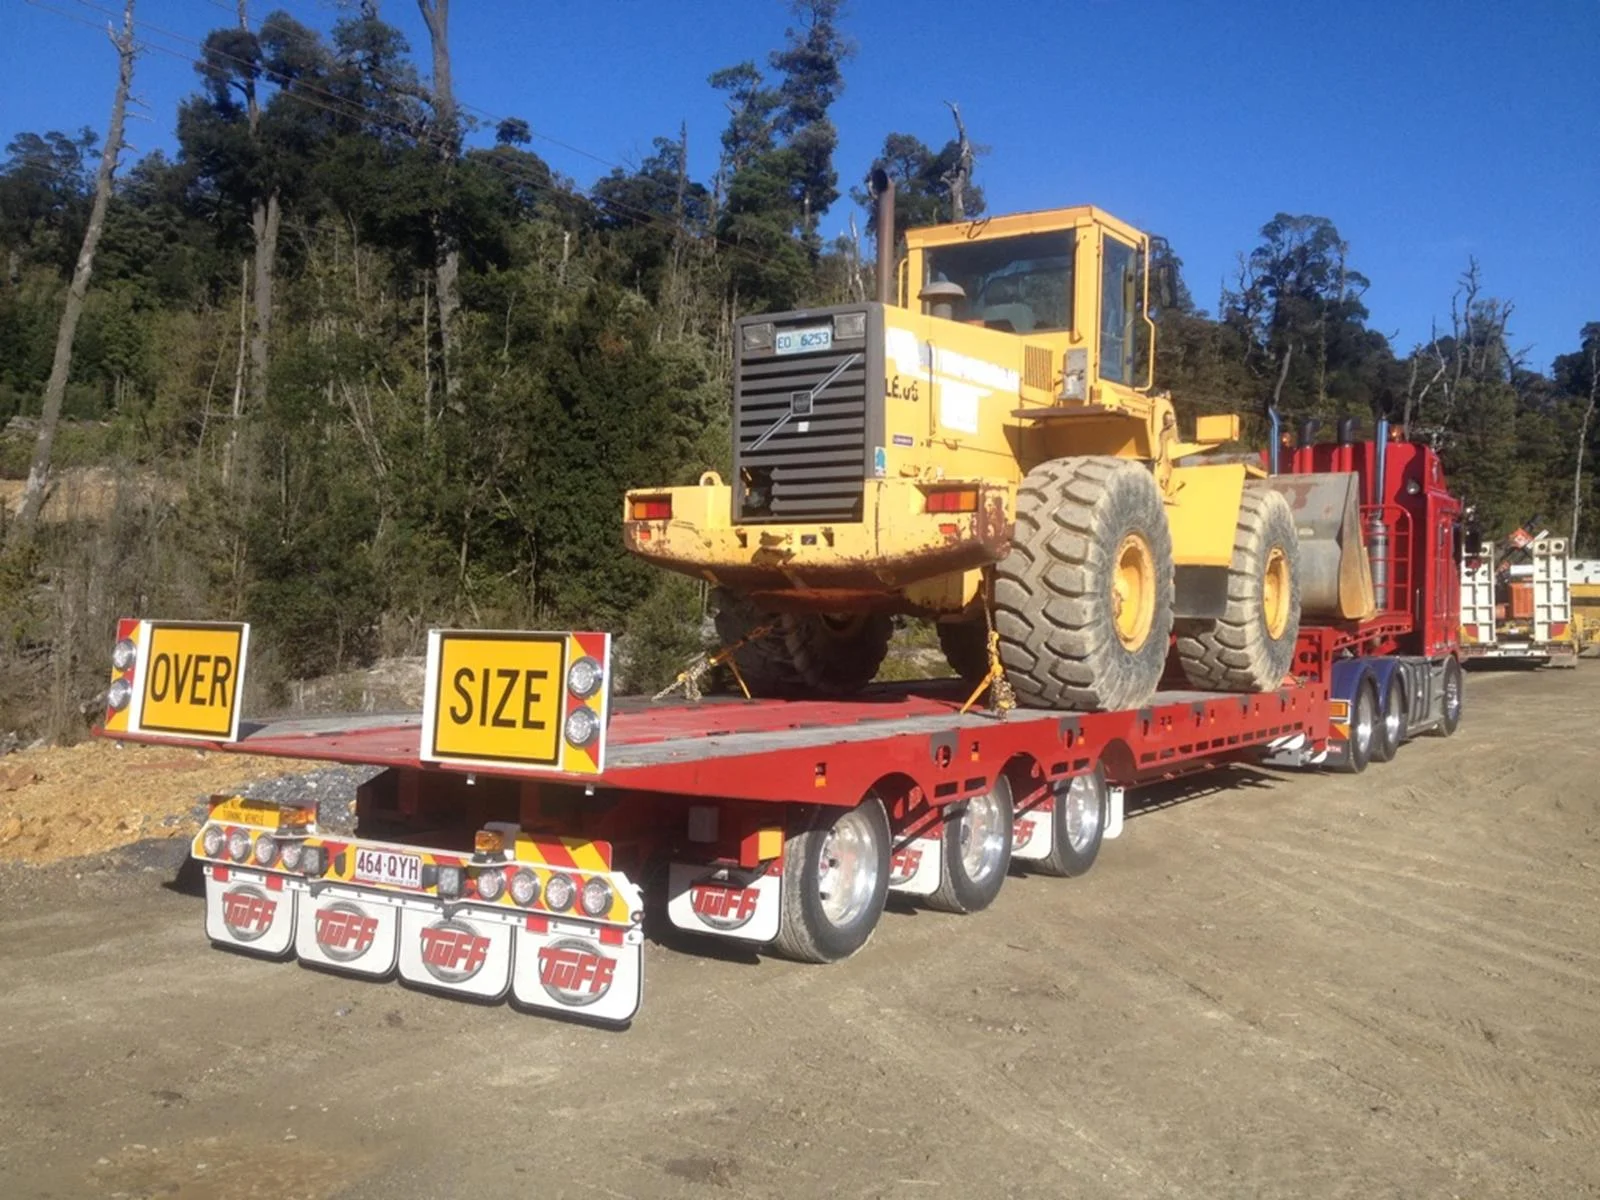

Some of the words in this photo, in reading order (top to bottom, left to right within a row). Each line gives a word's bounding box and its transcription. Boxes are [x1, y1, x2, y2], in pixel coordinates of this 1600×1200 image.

[800, 331, 829, 346] 6253
[150, 653, 233, 708] OVER
[449, 666, 548, 730] SIZE
